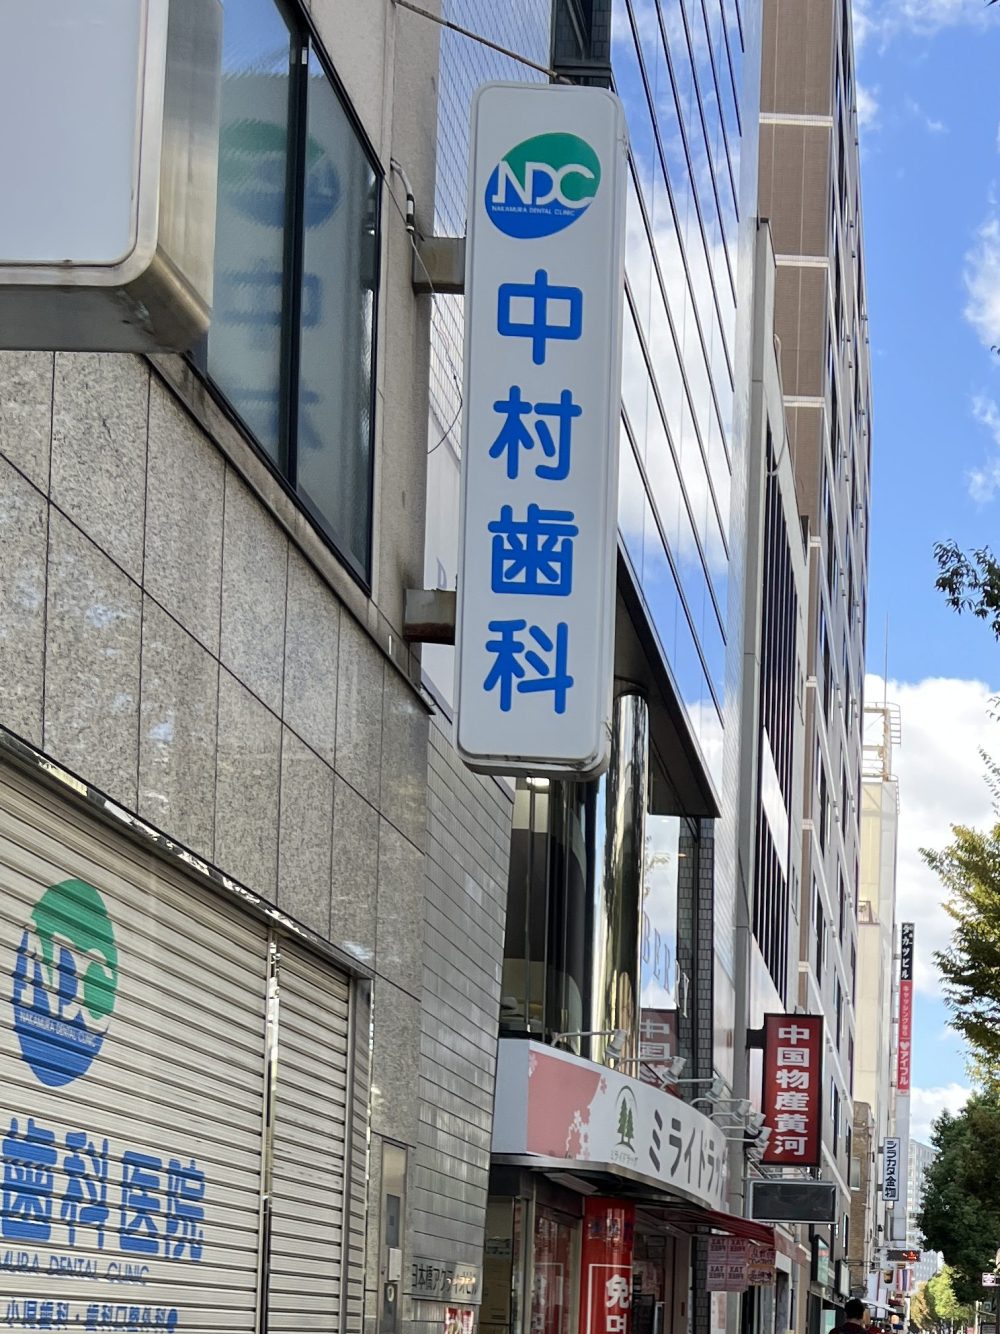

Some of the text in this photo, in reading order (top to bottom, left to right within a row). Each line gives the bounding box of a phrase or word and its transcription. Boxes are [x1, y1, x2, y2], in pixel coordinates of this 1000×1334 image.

[492, 160, 595, 209] NDC
[492, 206, 575, 217] NAKAMURA DENTAL CLINIC
[483, 269, 582, 714] 中村歯科
[20, 926, 113, 1033] NDC
[773, 1024, 810, 1156] 中国物産黄河
[2, 1117, 205, 1262] 歯科医院
[48, 1255, 98, 1279] DENTAL
